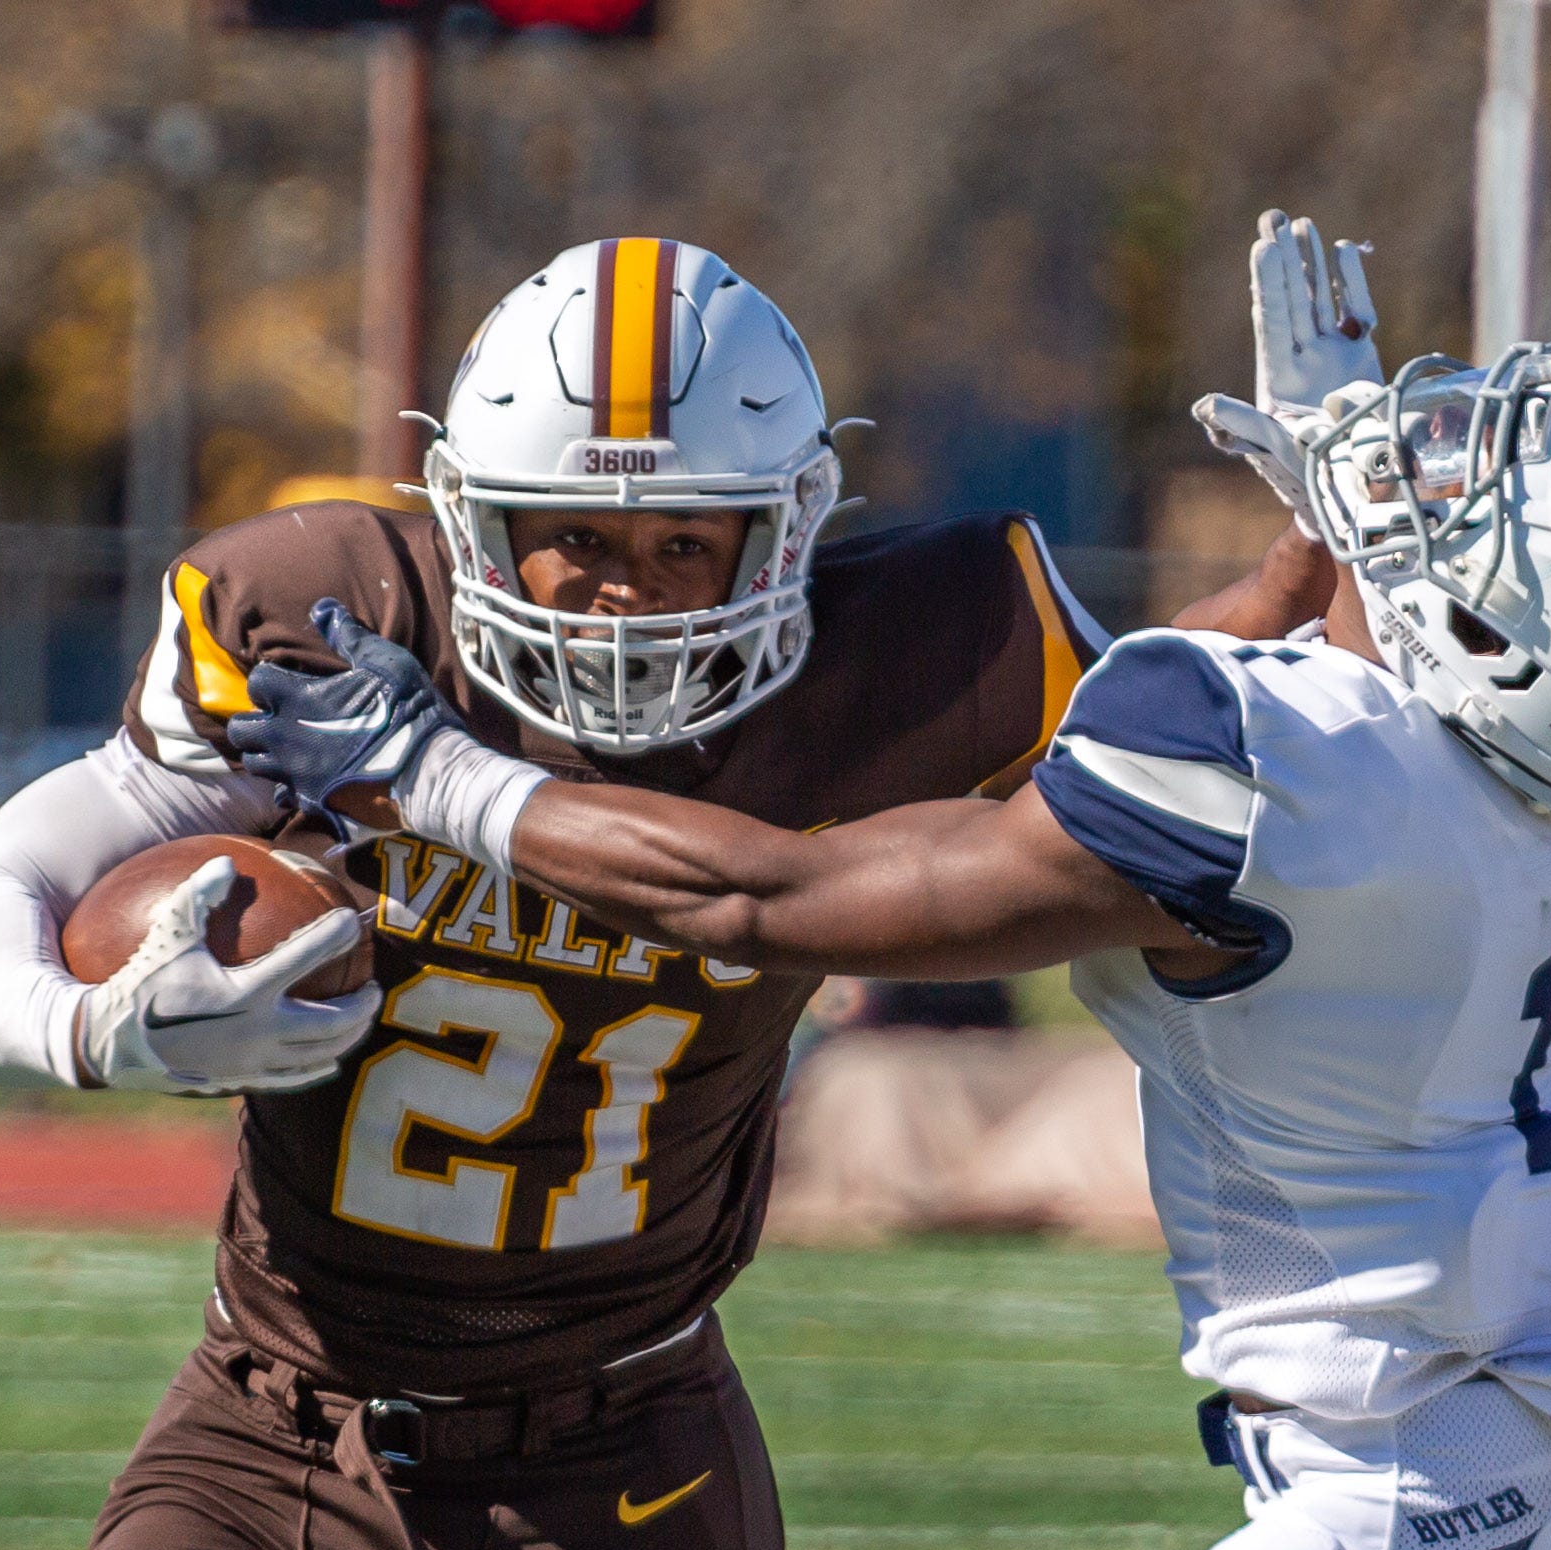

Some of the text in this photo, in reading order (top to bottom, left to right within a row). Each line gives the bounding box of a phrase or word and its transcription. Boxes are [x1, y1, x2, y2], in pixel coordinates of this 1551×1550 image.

[584, 447, 656, 474] 3600
[593, 706, 644, 721] Ridell
[331, 964, 702, 1252] 21
[1406, 1485, 1535, 1544] BUTLER
